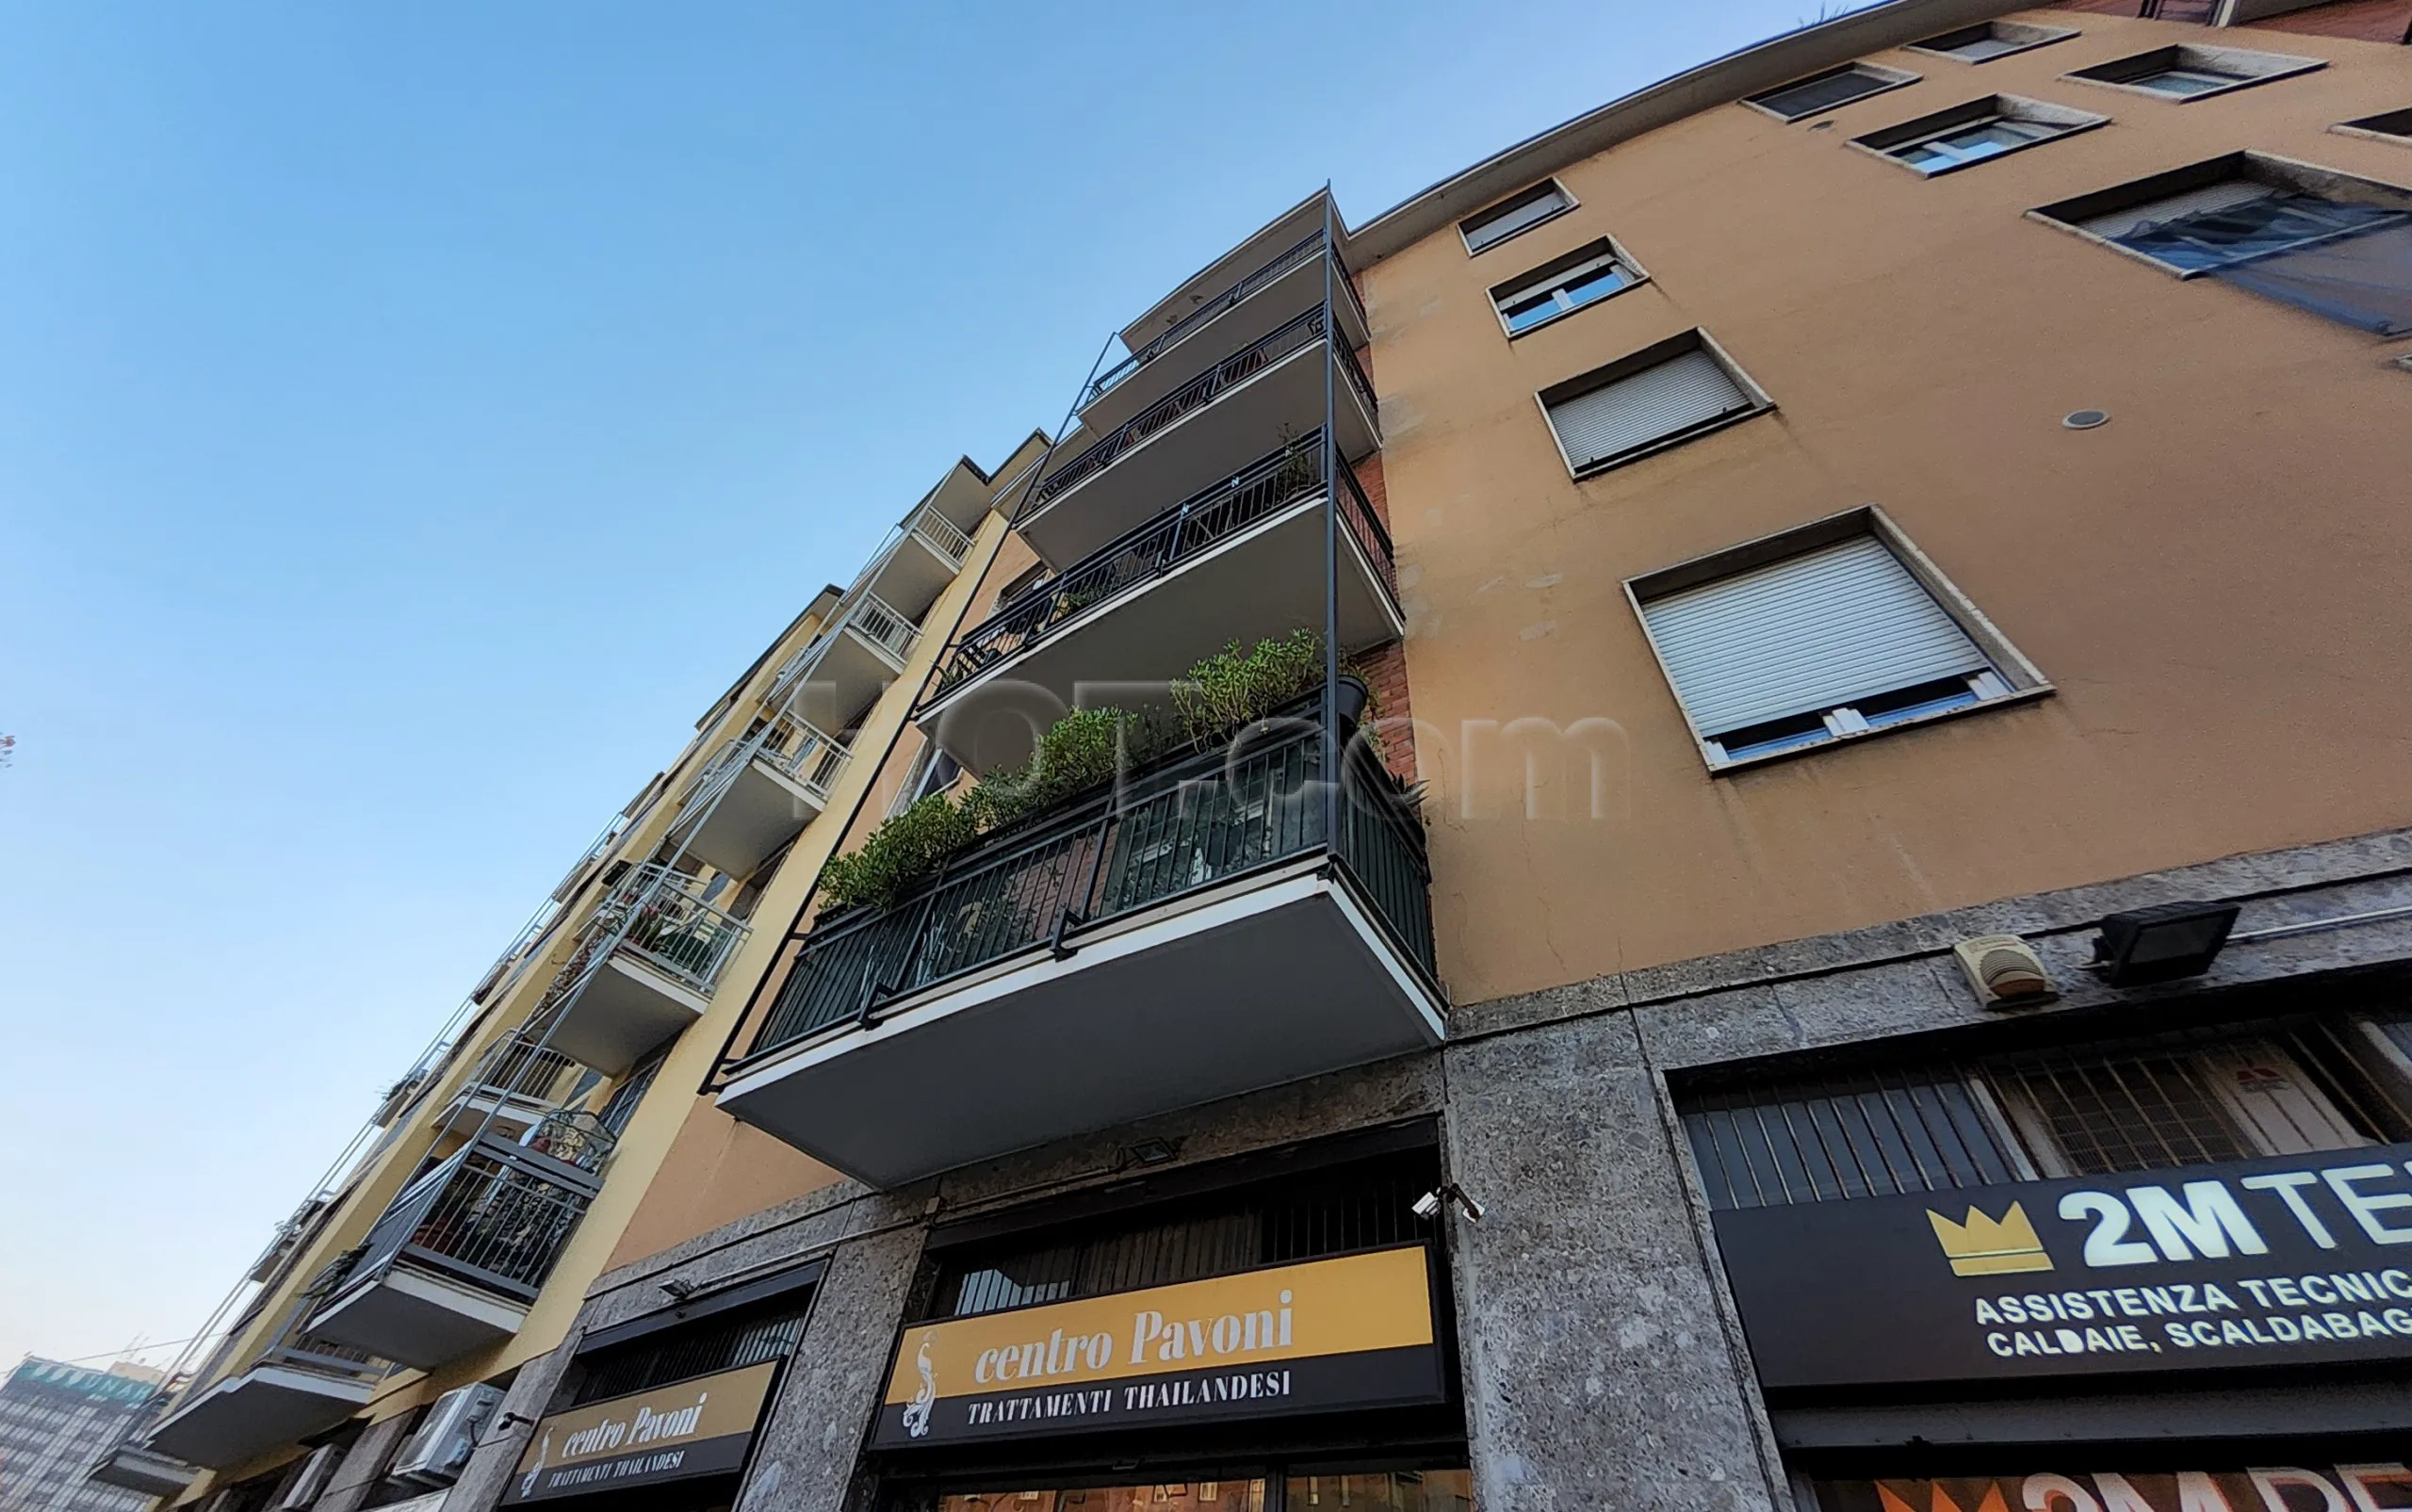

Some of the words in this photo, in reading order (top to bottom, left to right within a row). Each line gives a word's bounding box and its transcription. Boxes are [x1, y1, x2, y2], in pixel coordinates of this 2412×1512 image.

[1976, 1282, 2240, 1325] ASSISTENZA
[975, 1327, 1113, 1384] centro
[1129, 1290, 1294, 1364] Pavoni
[1987, 1324, 2162, 1358] CALDAIE,
[562, 1418, 627, 1458] centro
[626, 1391, 708, 1446] Pavoni
[967, 1387, 1113, 1425] TRATTAMENTI
[1123, 1369, 1292, 1411] THAILANDESI
